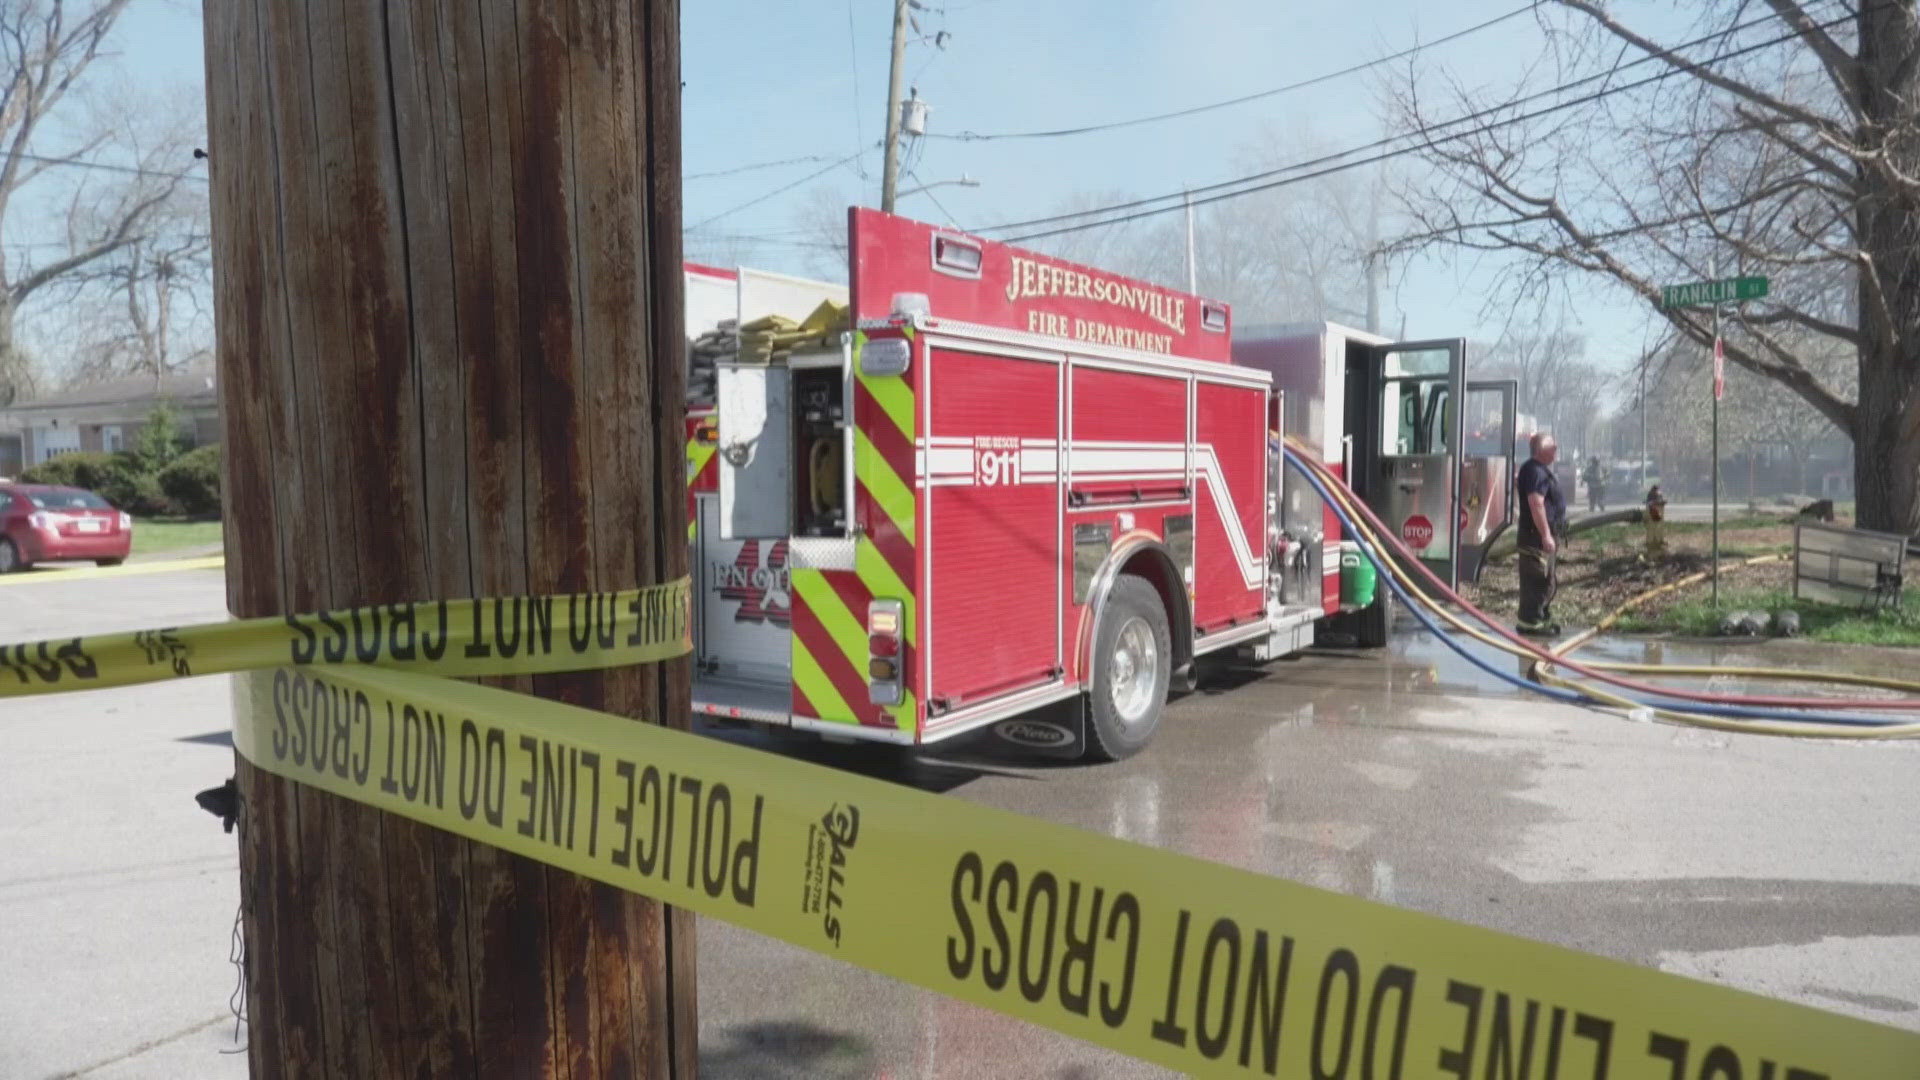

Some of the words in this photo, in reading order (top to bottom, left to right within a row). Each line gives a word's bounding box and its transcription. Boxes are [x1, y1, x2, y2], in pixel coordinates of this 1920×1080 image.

[1005, 255, 1186, 336] JEFFERSONVILLE
[1028, 309, 1069, 337] FIRE
[1075, 317, 1173, 355] DEPARTMENT
[1661, 280, 1737, 309] FRANKLIN
[981, 450, 1020, 487] 911
[1404, 525, 1433, 539] STOP
[286, 600, 448, 665] CROSS
[464, 595, 552, 658] NOT
[568, 591, 618, 655] DO
[272, 668, 372, 786] CROSS
[380, 699, 446, 810] NOT
[458, 718, 506, 829] DO
[517, 734, 600, 858] LINE
[611, 758, 764, 908] POLICE
[821, 802, 860, 948] GALLS
[946, 851, 1141, 1028] CROSS
[1150, 908, 1295, 1077] NOT
[1309, 948, 1417, 1080] DO
